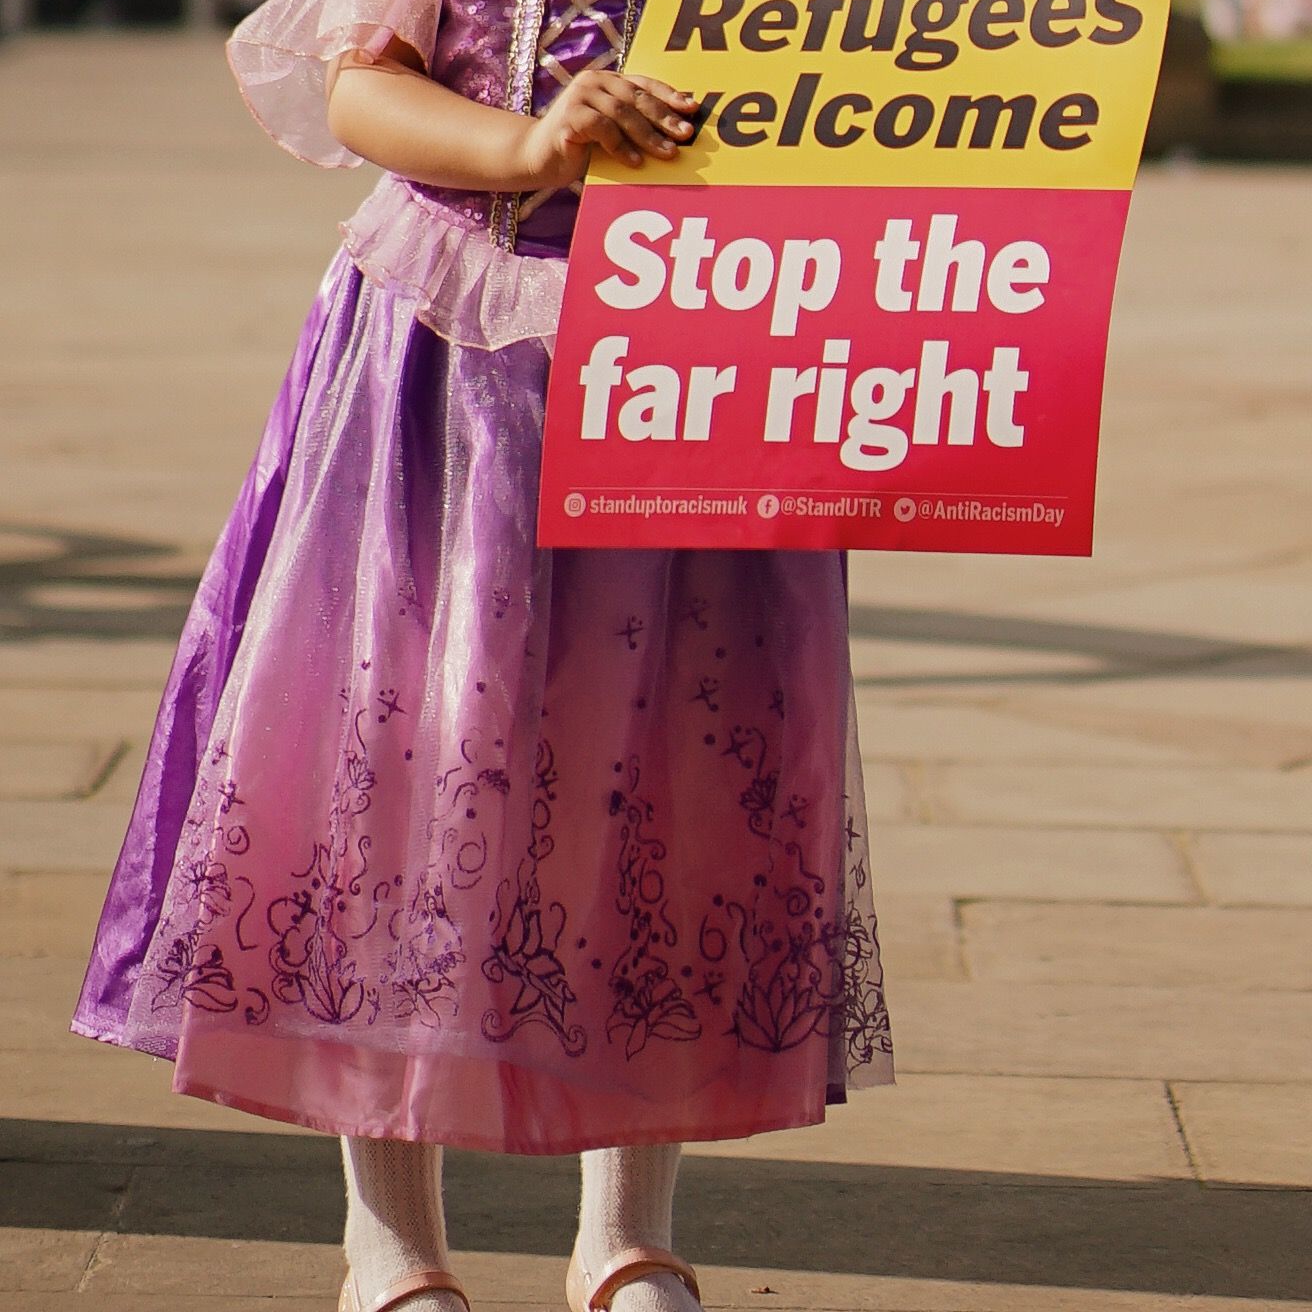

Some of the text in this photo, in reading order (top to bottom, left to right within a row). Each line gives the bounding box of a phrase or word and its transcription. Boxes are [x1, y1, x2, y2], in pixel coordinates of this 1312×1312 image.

[594, 209, 1052, 338] Stop the
[578, 335, 1031, 472] far right
[589, 493, 1066, 528] standuptoracismuk @StandUTR @AntiRacismDay
